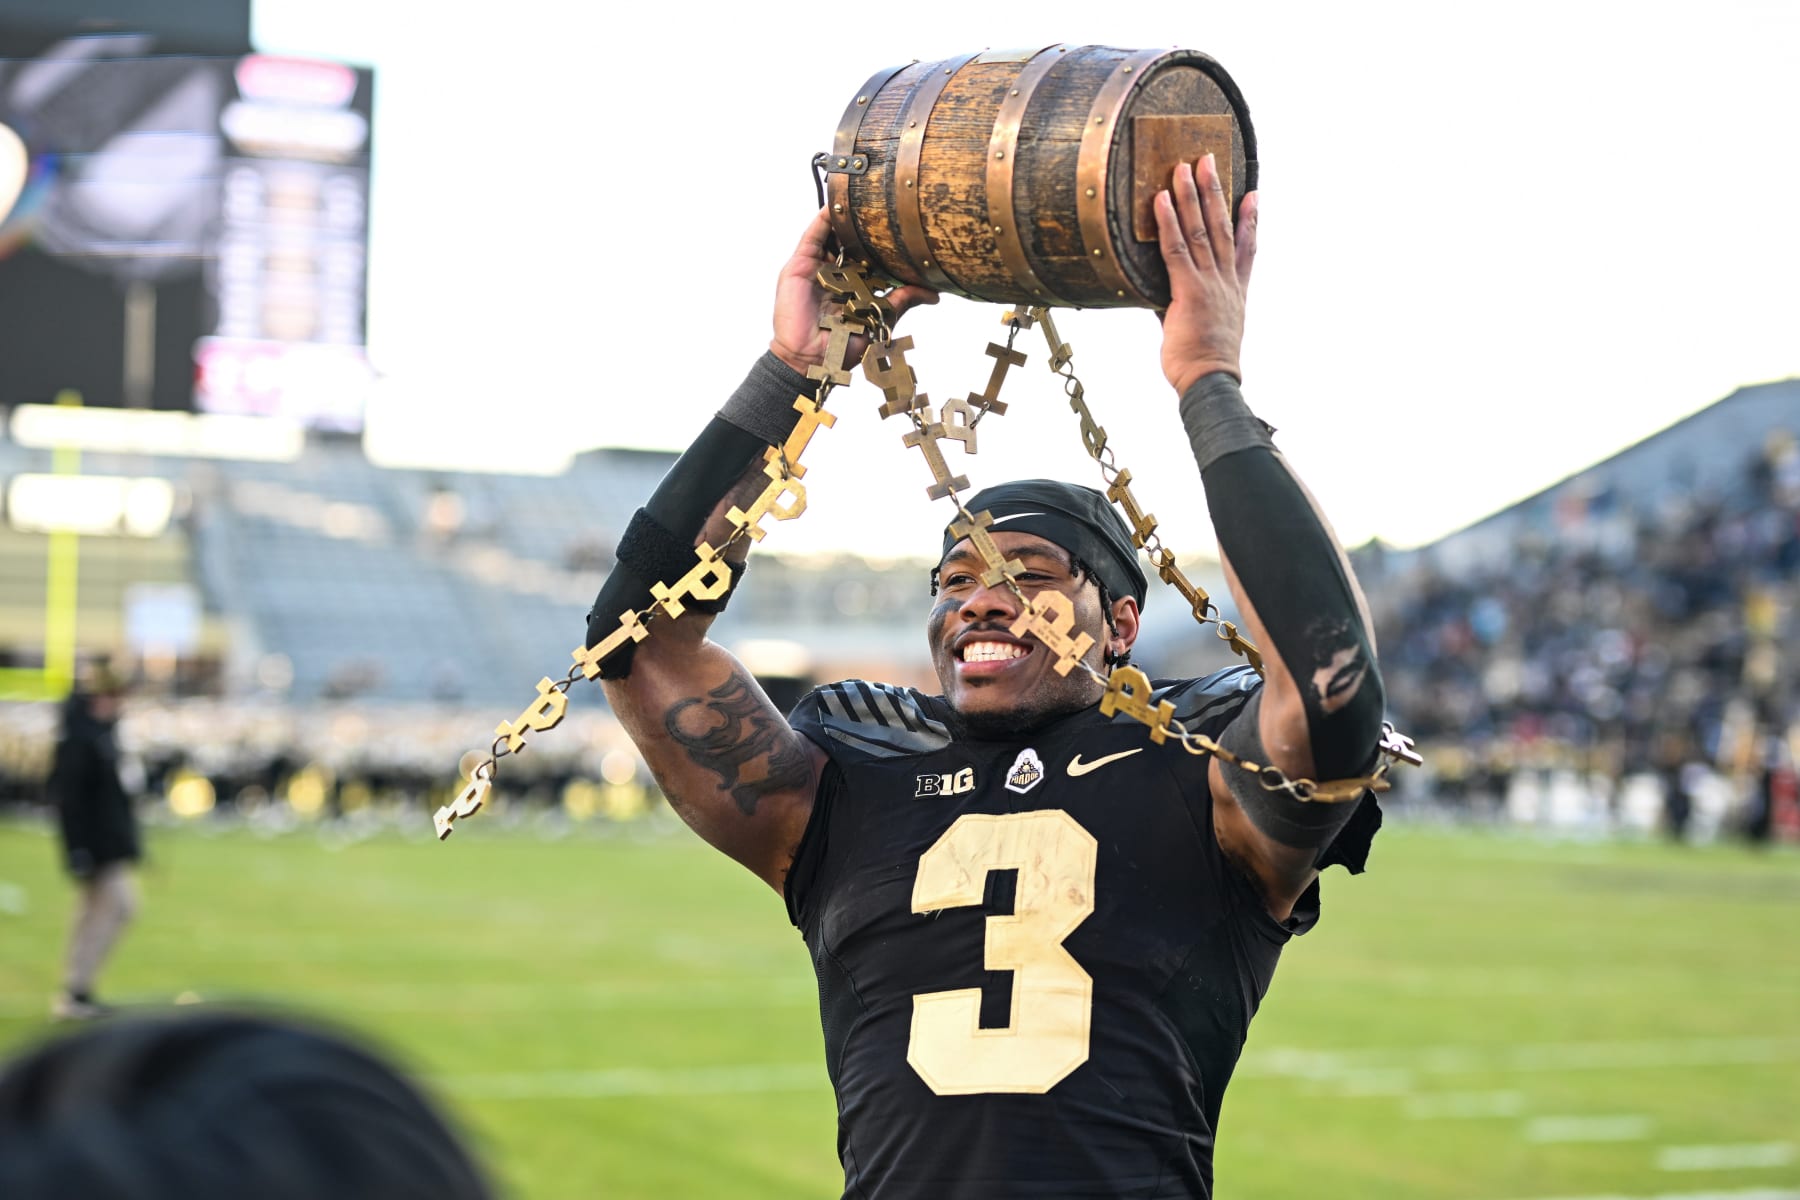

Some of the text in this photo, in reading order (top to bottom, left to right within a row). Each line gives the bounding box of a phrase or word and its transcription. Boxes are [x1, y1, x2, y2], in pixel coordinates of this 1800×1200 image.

[650, 541, 733, 619] P
[1009, 590, 1095, 677] P
[1099, 665, 1176, 745] P
[907, 809, 1098, 1096] 3
